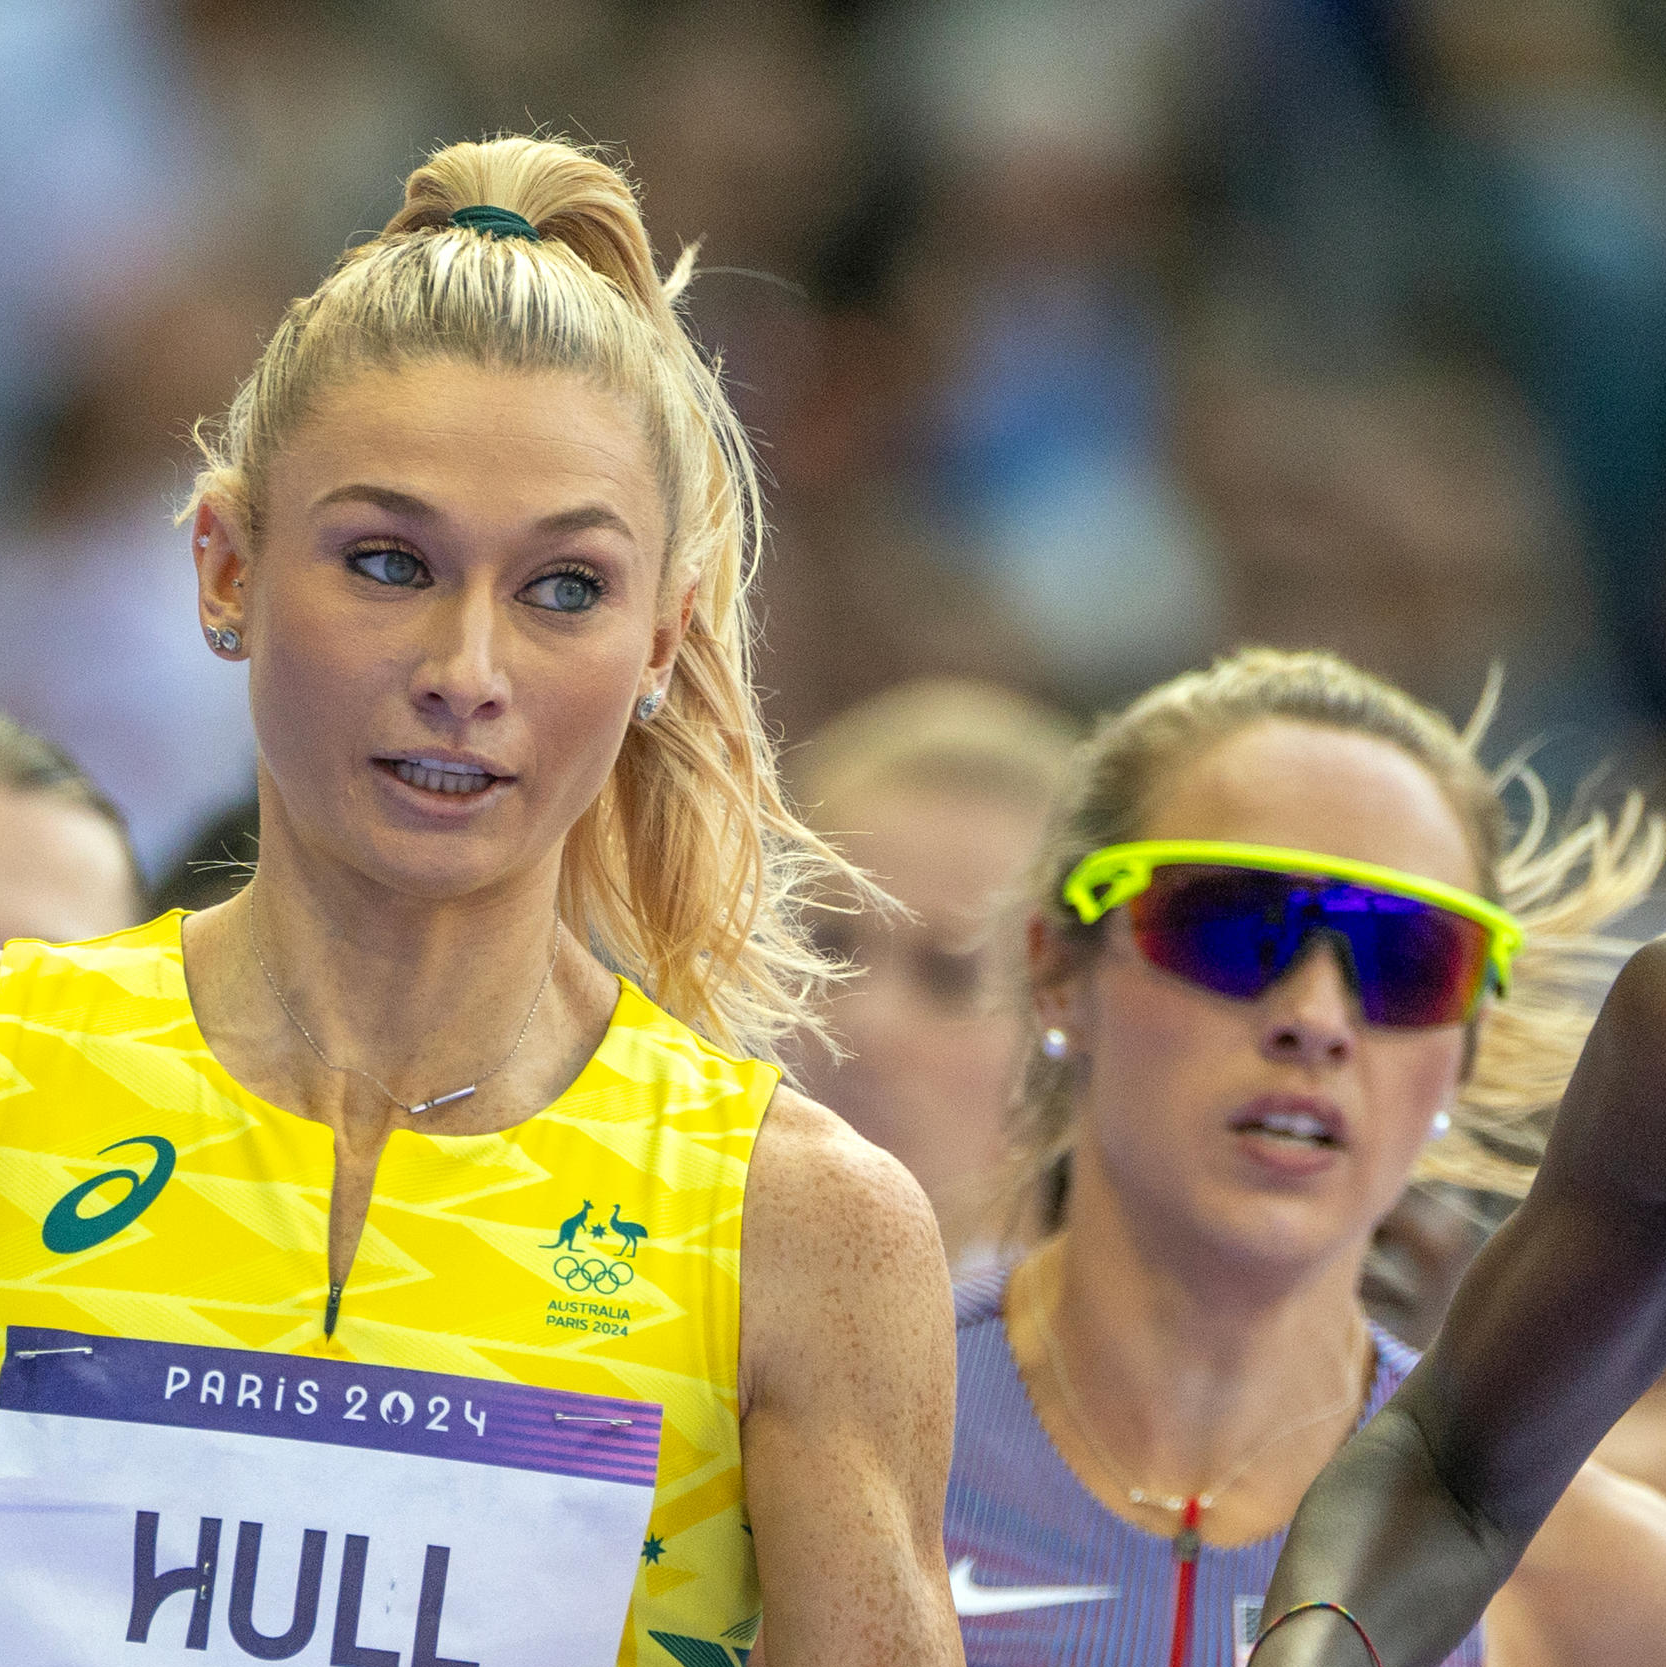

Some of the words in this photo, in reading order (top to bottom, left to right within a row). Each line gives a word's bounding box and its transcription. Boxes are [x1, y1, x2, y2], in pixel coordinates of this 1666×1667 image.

[547, 1299, 631, 1320] AUSTRALIA
[546, 1315, 588, 1331] PARIS
[592, 1320, 628, 1337] 2024
[342, 1385, 487, 1437] 2024
